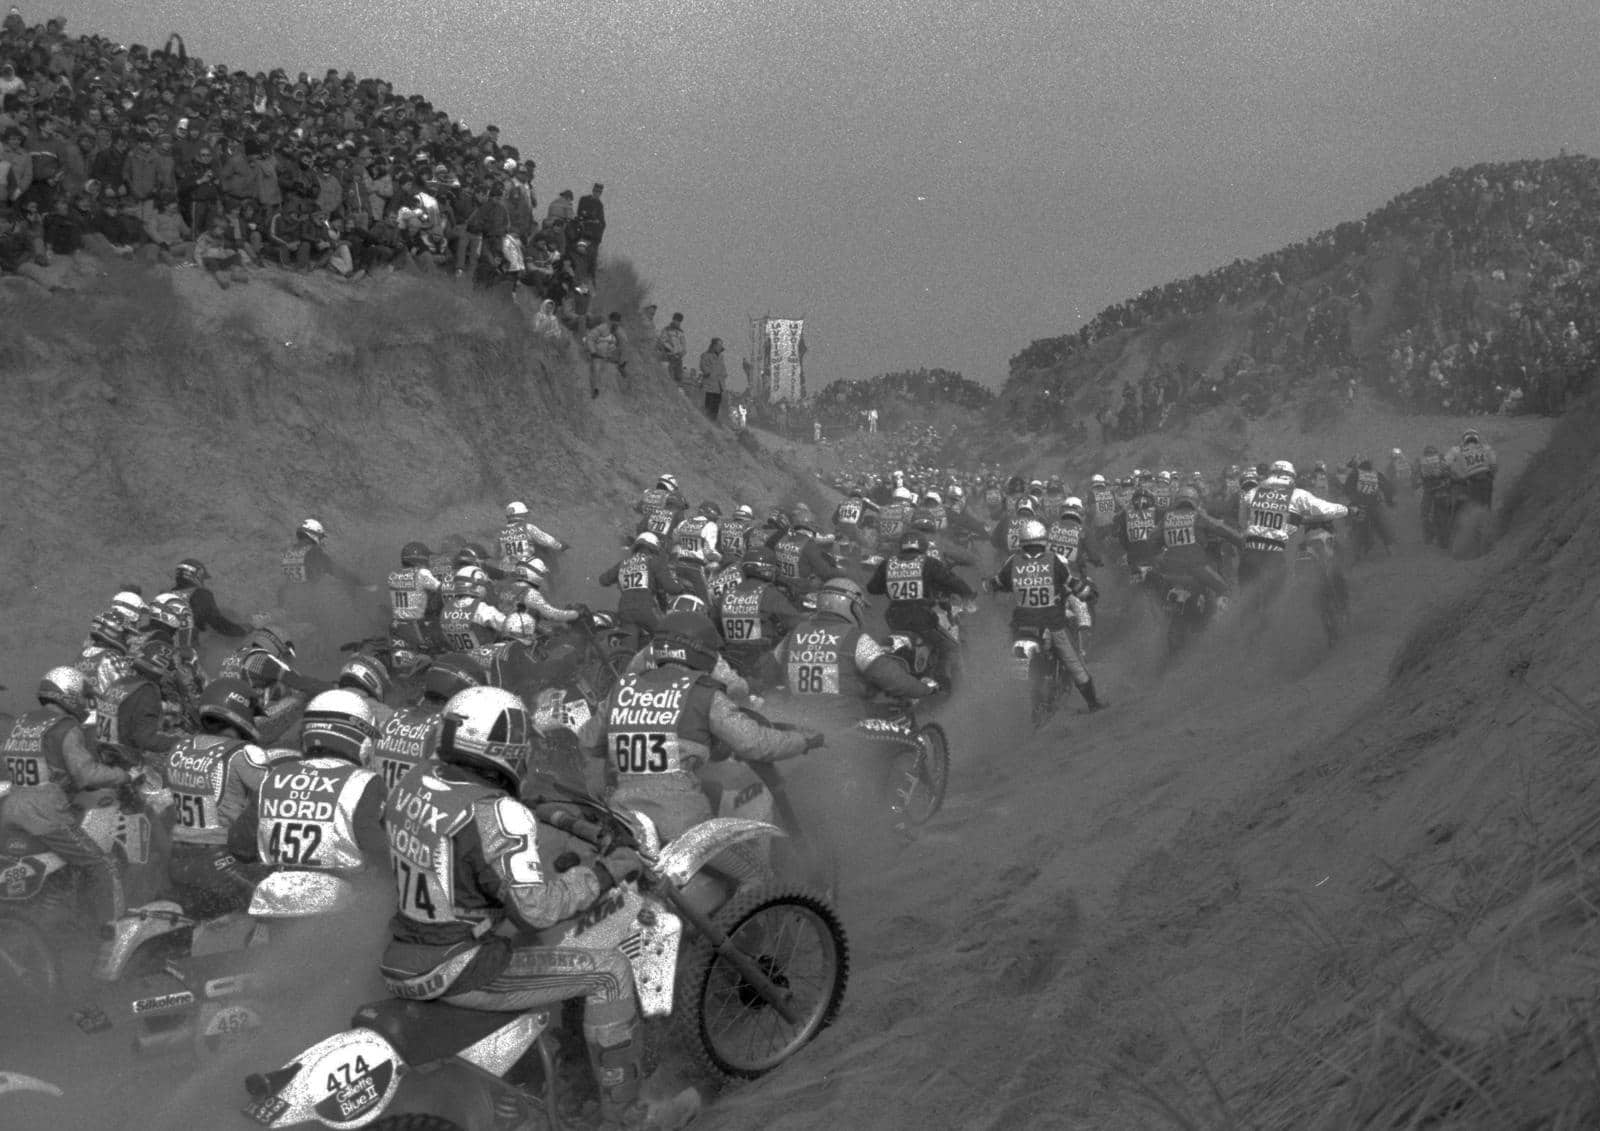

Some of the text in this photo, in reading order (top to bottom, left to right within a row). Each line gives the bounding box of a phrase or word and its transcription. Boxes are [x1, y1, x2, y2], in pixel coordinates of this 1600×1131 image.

[1258, 492, 1288, 501] VOIX
[1252, 501, 1288, 512] NORD
[1254, 511, 1283, 530] 1100
[1168, 529, 1191, 545] 1141
[1015, 563, 1050, 574] VOIX
[890, 582, 918, 599] 249
[1018, 588, 1050, 607] 756
[444, 611, 472, 620] VOIX
[726, 619, 755, 639] 997
[796, 632, 840, 645] VOIX
[788, 650, 837, 663] NORD
[798, 666, 822, 693] 86
[610, 707, 681, 725] Mutuel
[376, 735, 424, 758] Mutuel
[616, 733, 668, 773] 603
[7, 758, 40, 786] 589
[301, 768, 318, 776] LA
[274, 773, 340, 793] VOIX
[289, 790, 310, 800] DU
[416, 787, 431, 802] LA
[263, 798, 333, 820] NORD
[394, 788, 448, 834] VOIX
[269, 822, 322, 865] 452
[386, 820, 431, 868] NORD
[326, 1054, 370, 1093] 474
[339, 1092, 368, 1116] Blue
